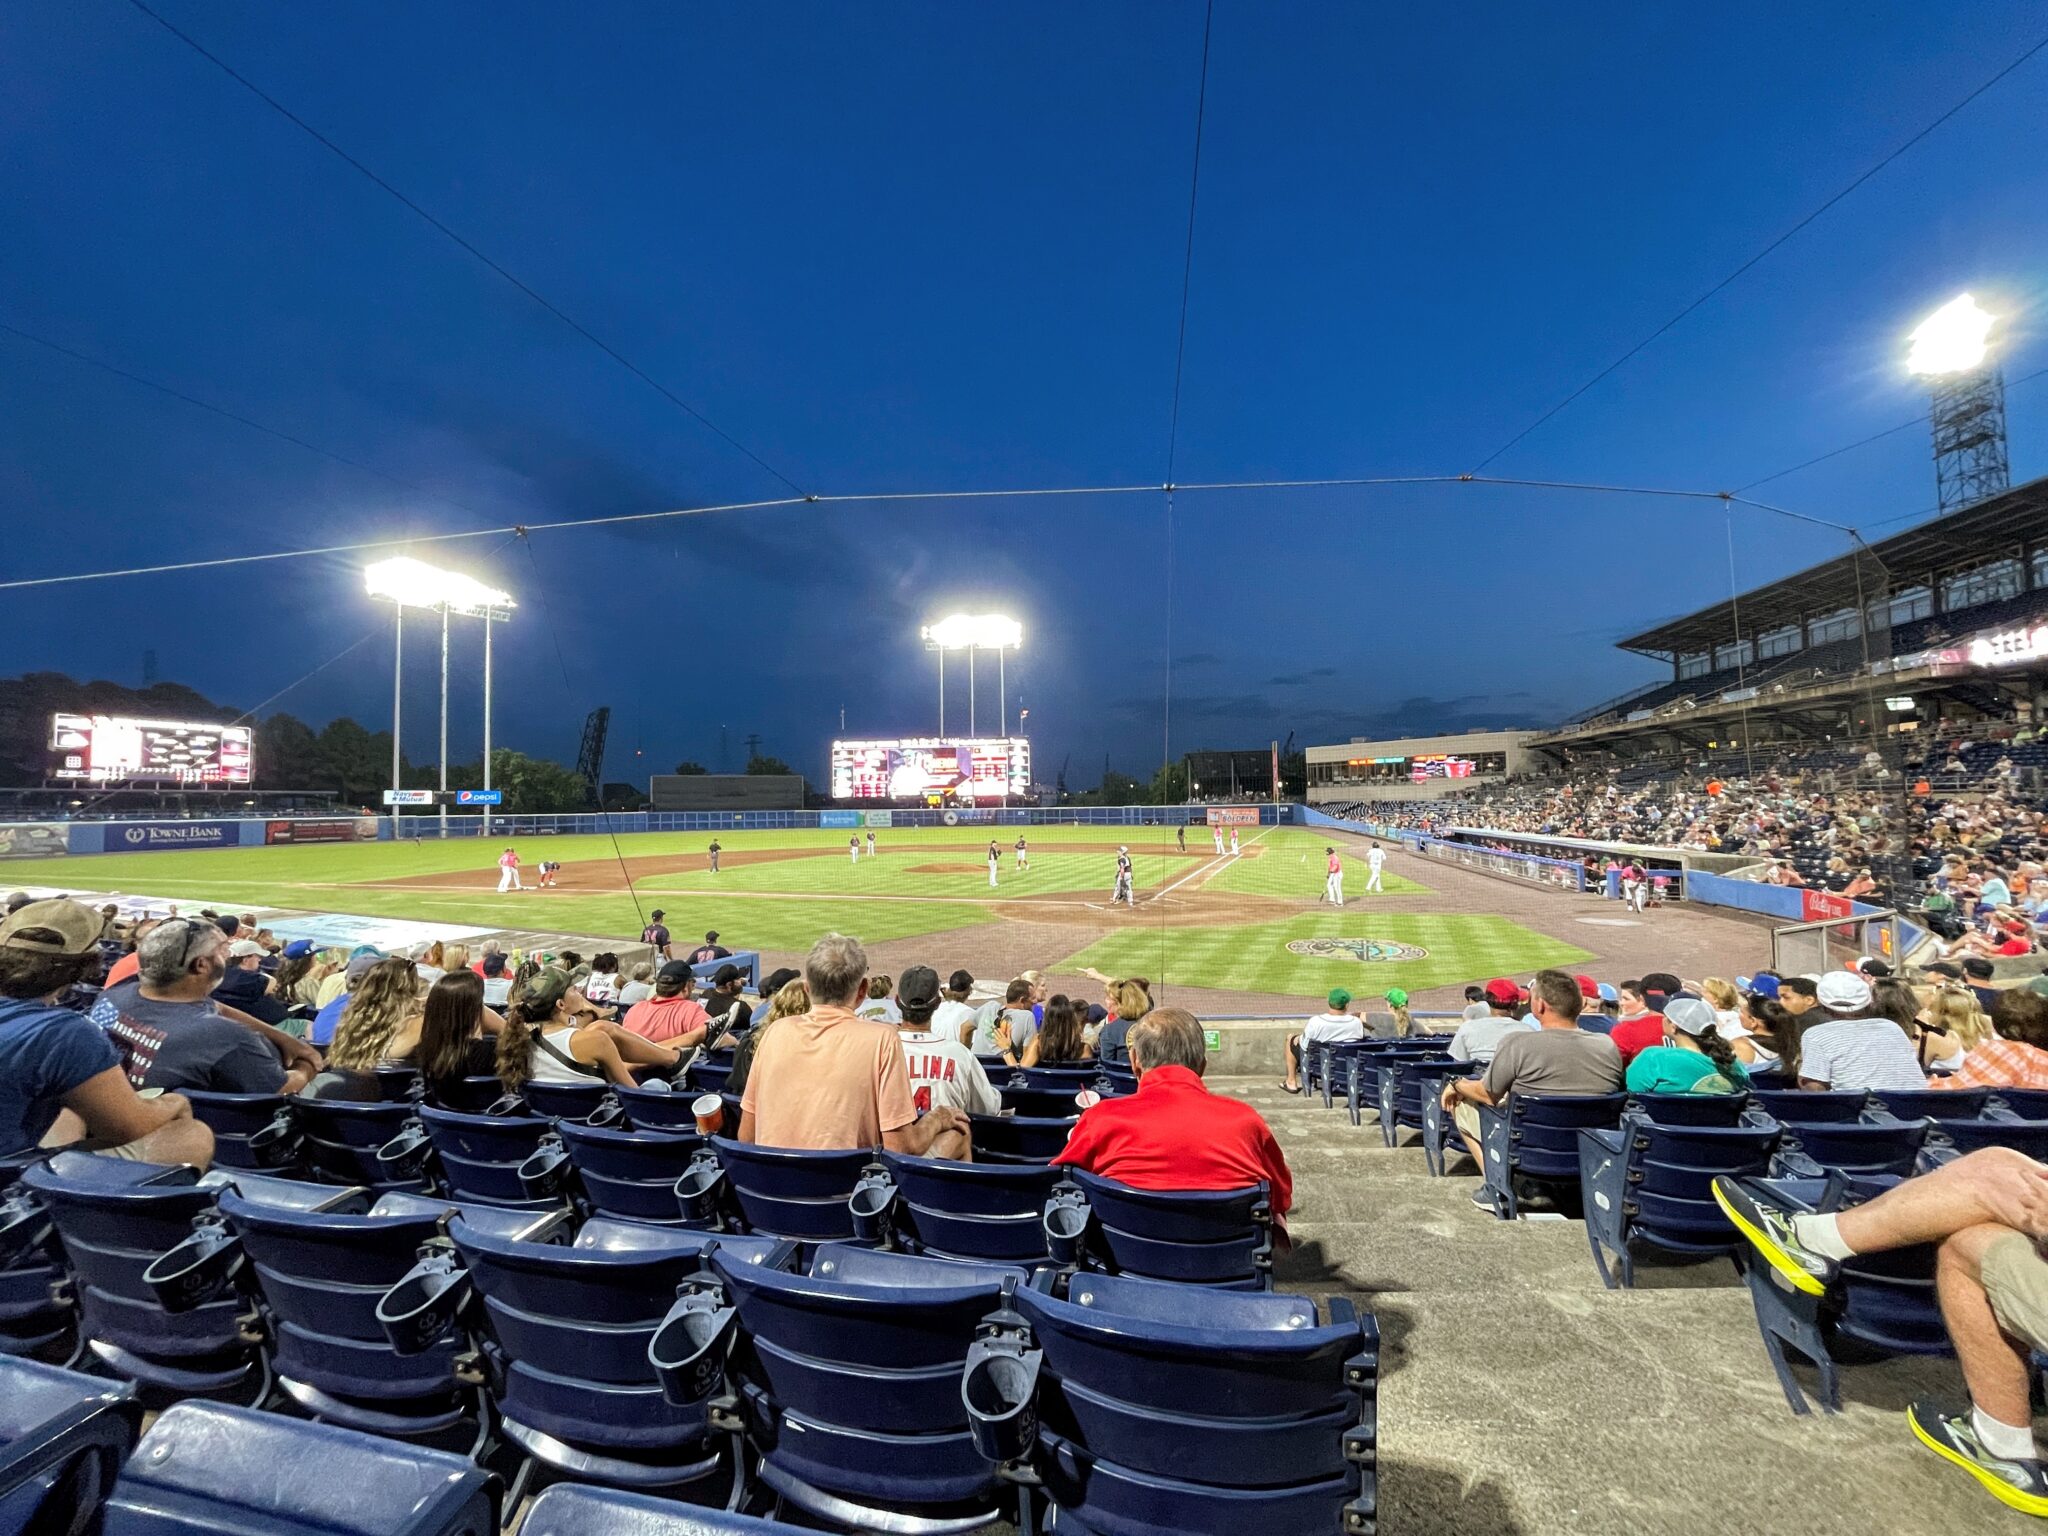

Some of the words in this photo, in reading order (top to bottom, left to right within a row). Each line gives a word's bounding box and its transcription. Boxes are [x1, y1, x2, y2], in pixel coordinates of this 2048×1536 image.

[473, 793, 498, 802] pepsi
[909, 1055, 956, 1083] LINA
[913, 1086, 931, 1111] 4
